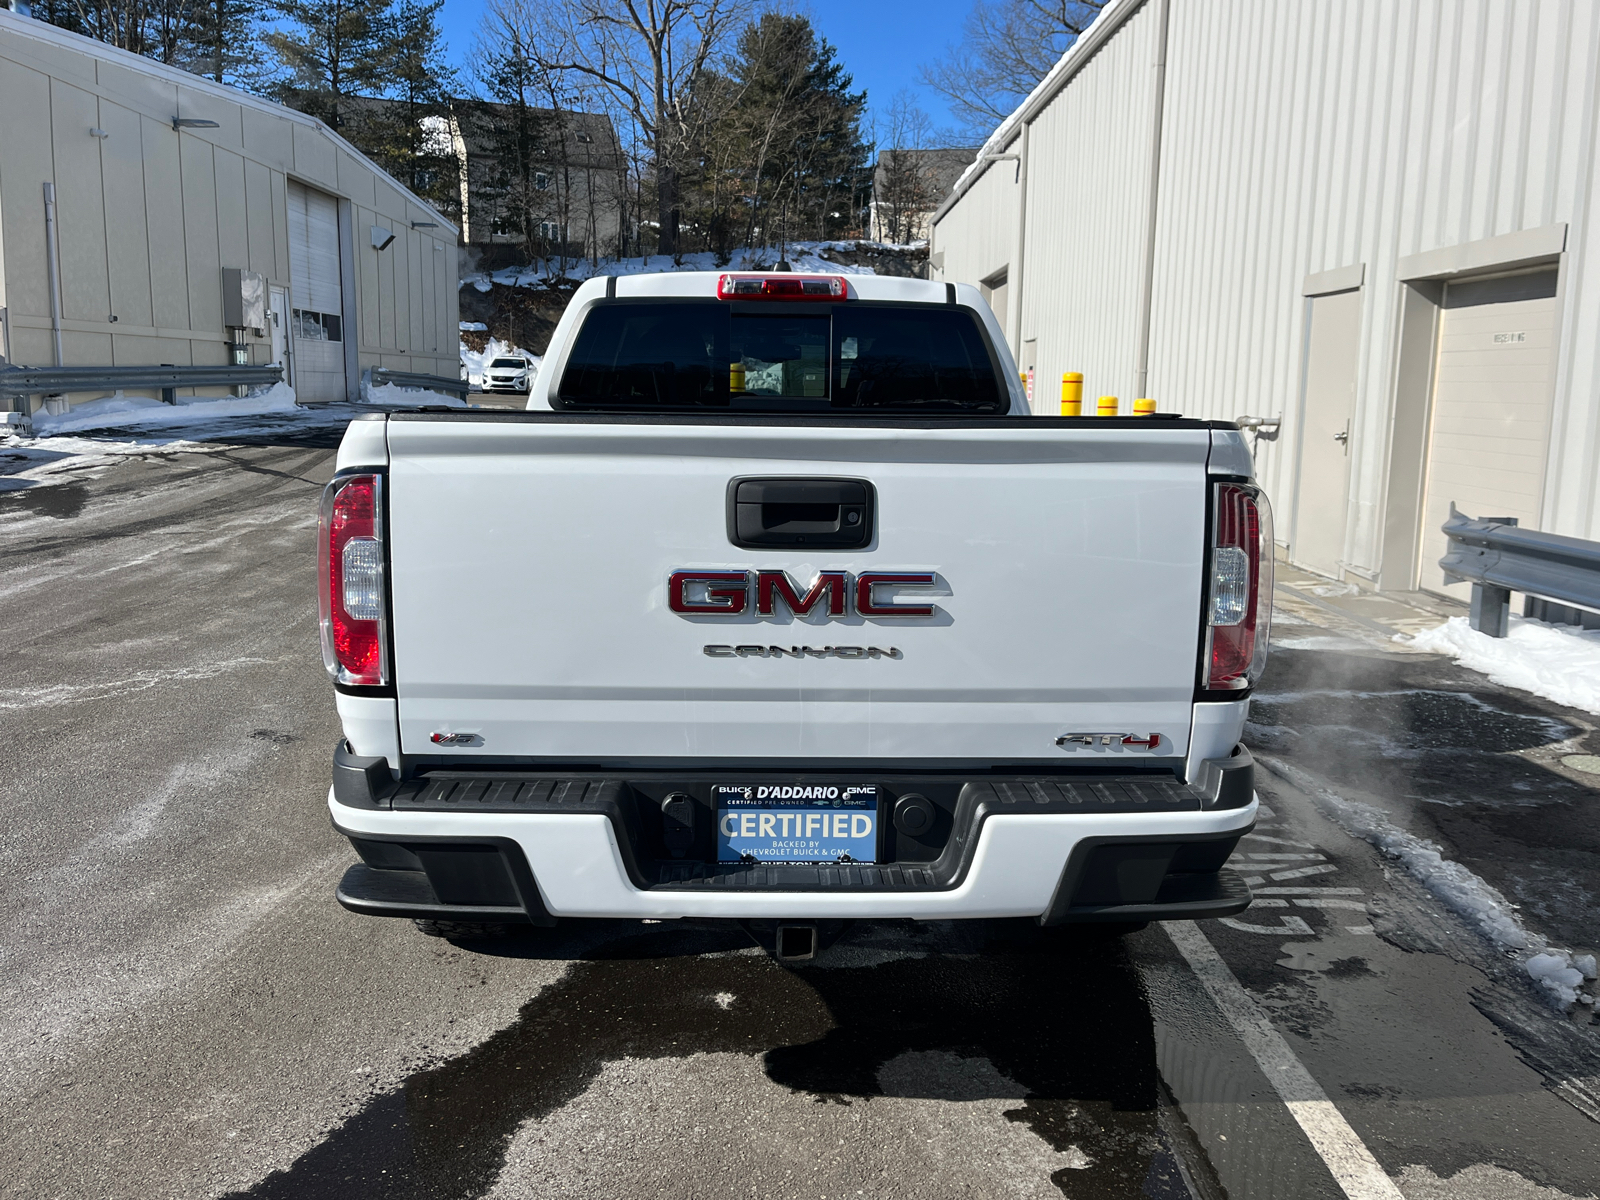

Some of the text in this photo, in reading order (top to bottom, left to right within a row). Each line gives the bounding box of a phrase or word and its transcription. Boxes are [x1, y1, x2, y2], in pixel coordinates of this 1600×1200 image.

[667, 569, 936, 617] GMC
[703, 644, 899, 657] CANYON
[1054, 732, 1161, 750] AT4
[718, 786, 752, 794] BUICK
[756, 786, 839, 799] D'ADDARIO
[720, 813, 873, 838] CERTIFIED
[772, 840, 820, 848] BACKED BY
[741, 848, 851, 856] CHEVROLET BUICK & GMC
